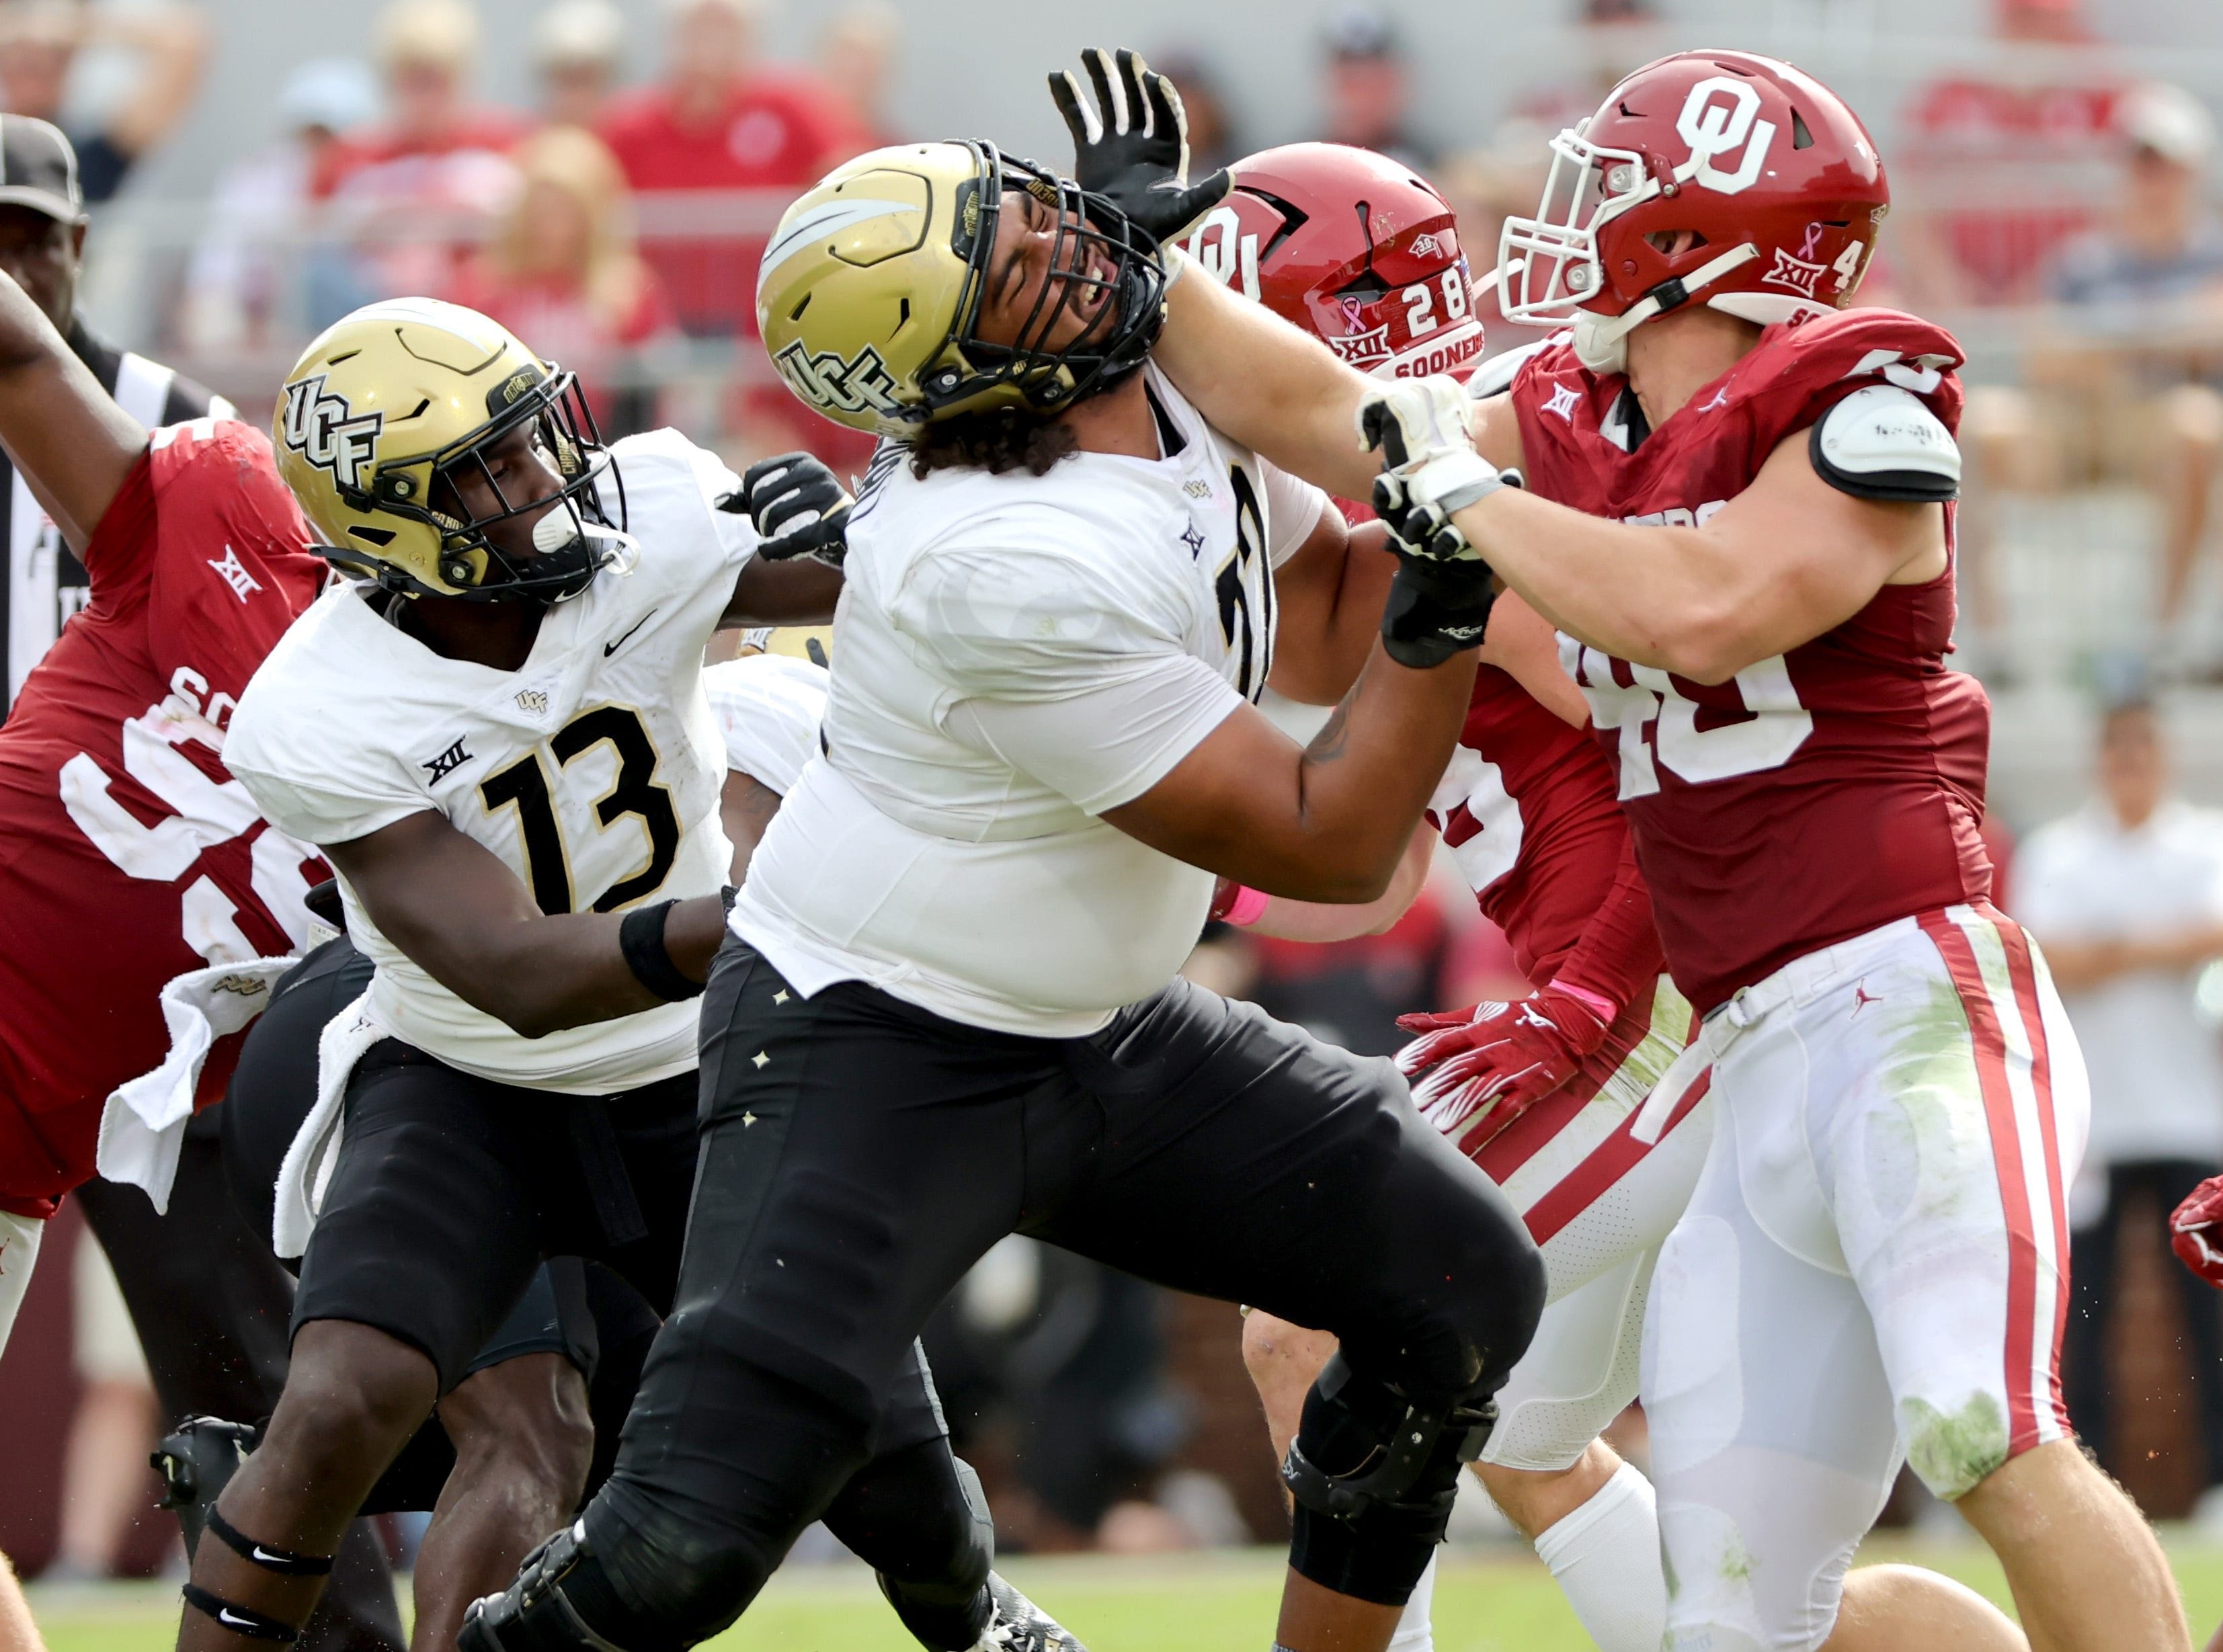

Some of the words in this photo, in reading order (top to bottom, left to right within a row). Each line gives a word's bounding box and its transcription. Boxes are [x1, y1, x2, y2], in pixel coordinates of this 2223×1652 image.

[1675, 75, 1777, 196] OU
[1416, 237, 1432, 251] 3.0
[1767, 248, 1825, 296] XII
[1832, 239, 1875, 297] 4
[1401, 267, 1466, 338] 28
[1331, 325, 1393, 364] XII
[773, 337, 903, 419] UCF
[1540, 381, 1582, 421] XII
[284, 374, 384, 494] UCF
[1183, 479, 1213, 499] UCF
[206, 543, 264, 604] XII
[514, 689, 548, 714] UCF
[1554, 629, 1814, 801] 40
[421, 733, 475, 788] XII
[475, 699, 684, 917] 73
